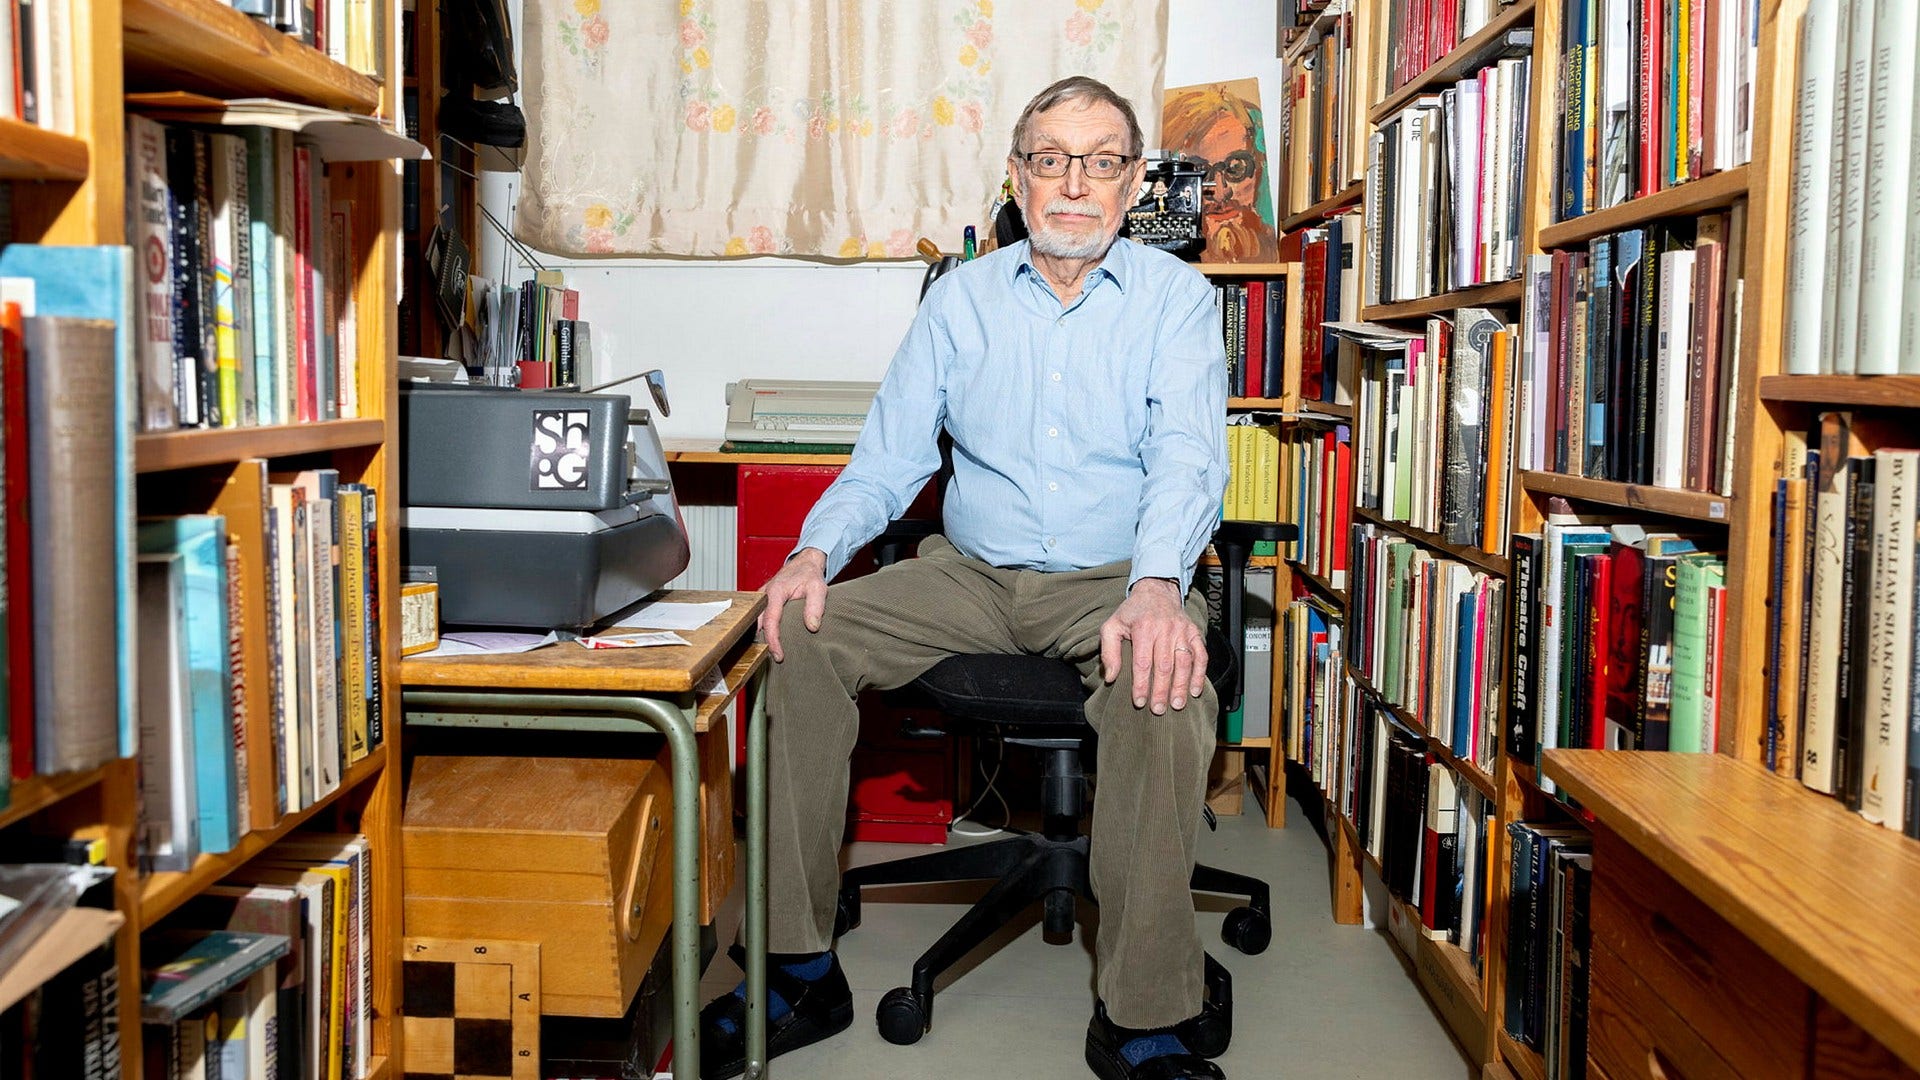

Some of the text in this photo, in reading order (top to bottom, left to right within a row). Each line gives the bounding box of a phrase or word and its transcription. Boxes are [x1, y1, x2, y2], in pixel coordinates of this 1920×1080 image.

[1641, 34, 1649, 49] ON
[1641, 51, 1649, 70] THE
[1567, 48, 1576, 131] SHAKESPEARE
[1573, 44, 1583, 131] APPROPRIATING
[1641, 73, 1649, 115] GERMAN
[1640, 117, 1648, 144] STAGE
[1830, 70, 1849, 234] BRITISH DRAMA
[1846, 60, 1866, 229] BRITISH DRAMA
[1869, 47, 1891, 222] BRITISH DRAMA
[1798, 76, 1817, 237] BRITISH DRAMA
[1272, 290, 1281, 300] 10
[1645, 240, 1656, 327] SHAKESPEARE
[1660, 258, 1670, 329] SHAKESPEARE
[1694, 334, 1704, 379] 1599
[1572, 375, 1580, 453] SHAKESPEARE
[1658, 377, 1666, 416] PLAYER
[1244, 432, 1252, 442] Ny
[1244, 464, 1252, 504] teaterhistoria
[1263, 464, 1271, 504] teaterhistoria
[1806, 460, 1818, 508] Carnival
[1806, 510, 1816, 532] and
[1848, 521, 1854, 530] A
[1804, 535, 1814, 574] Theater
[1844, 533, 1854, 570] History
[1845, 572, 1854, 583] of
[320, 540, 334, 700] THE MAMMOTH BOOK OF
[347, 509, 363, 719] Shakespearean Detectives
[1842, 583, 1853, 649] Shakespeare
[1871, 532, 1884, 668] ROBERT PAYNE
[1878, 458, 1904, 747] BY ME, WILLIAM SHAKESPEARE
[1516, 556, 1530, 711] Theatre Craft
[1706, 598, 1714, 693] EVERYTHING
[1810, 630, 1822, 688] STANLEY
[1842, 650, 1849, 662] on
[372, 656, 380, 702] JUDITH
[1635, 627, 1649, 742] SHAKESPEARE'S
[1840, 664, 1849, 698] Screen
[1810, 694, 1819, 736] WELLS
[416, 944, 428, 952] 7
[474, 946, 487, 954] 8
[518, 992, 531, 1002] A
[518, 1050, 531, 1058] B
